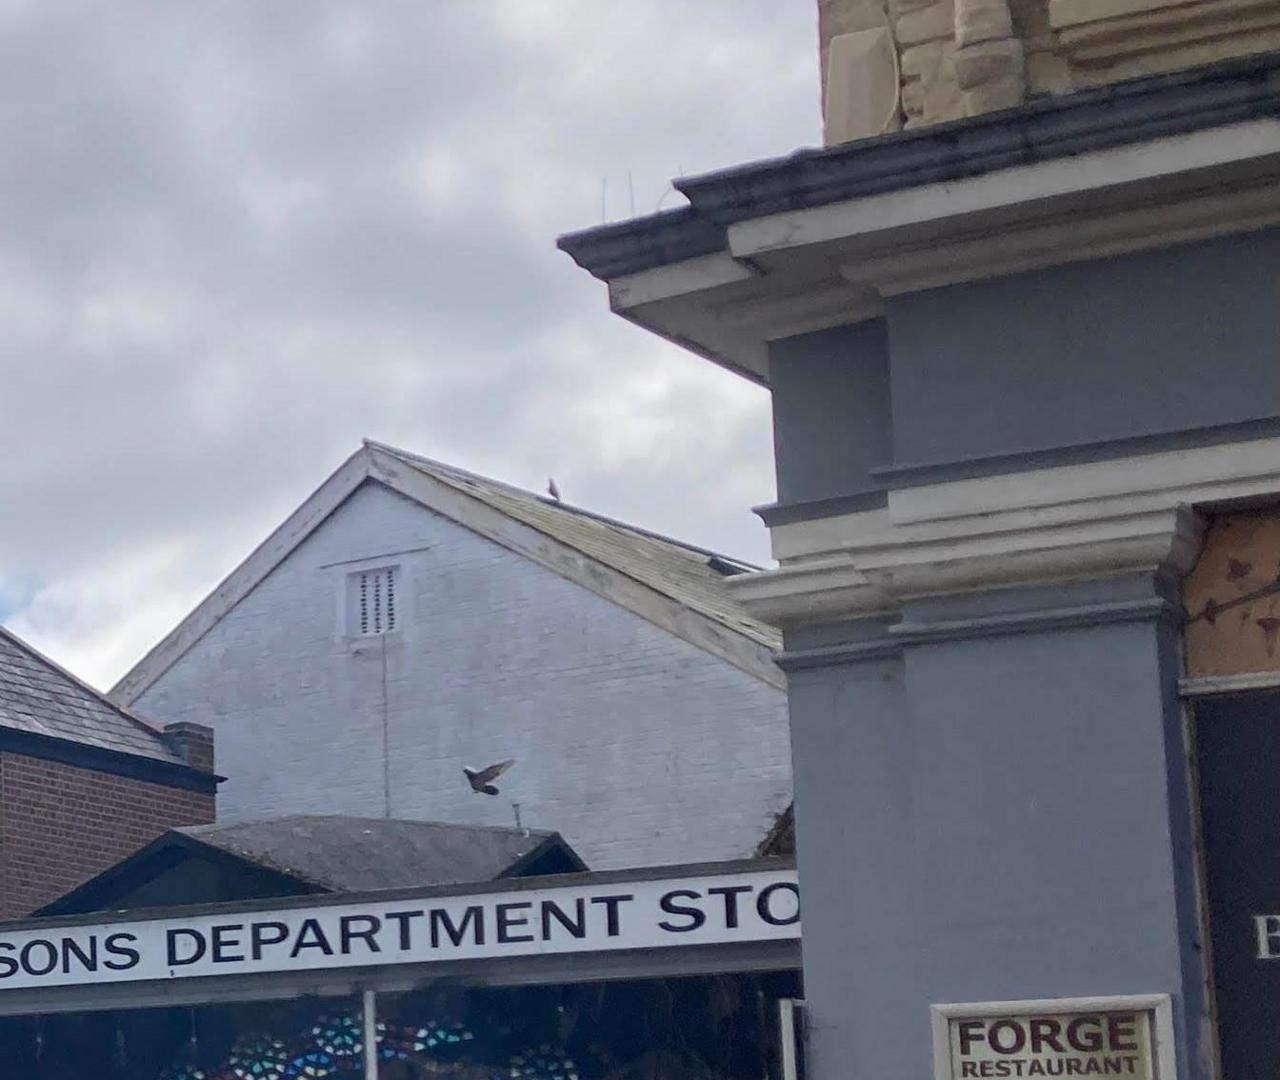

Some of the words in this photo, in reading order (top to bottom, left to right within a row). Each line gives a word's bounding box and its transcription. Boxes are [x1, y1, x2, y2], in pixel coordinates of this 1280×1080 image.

[166, 893, 635, 967] DEPARTMENT
[958, 1016, 1139, 1056] FORGE
[961, 1055, 1140, 1078] RESTAURANT
